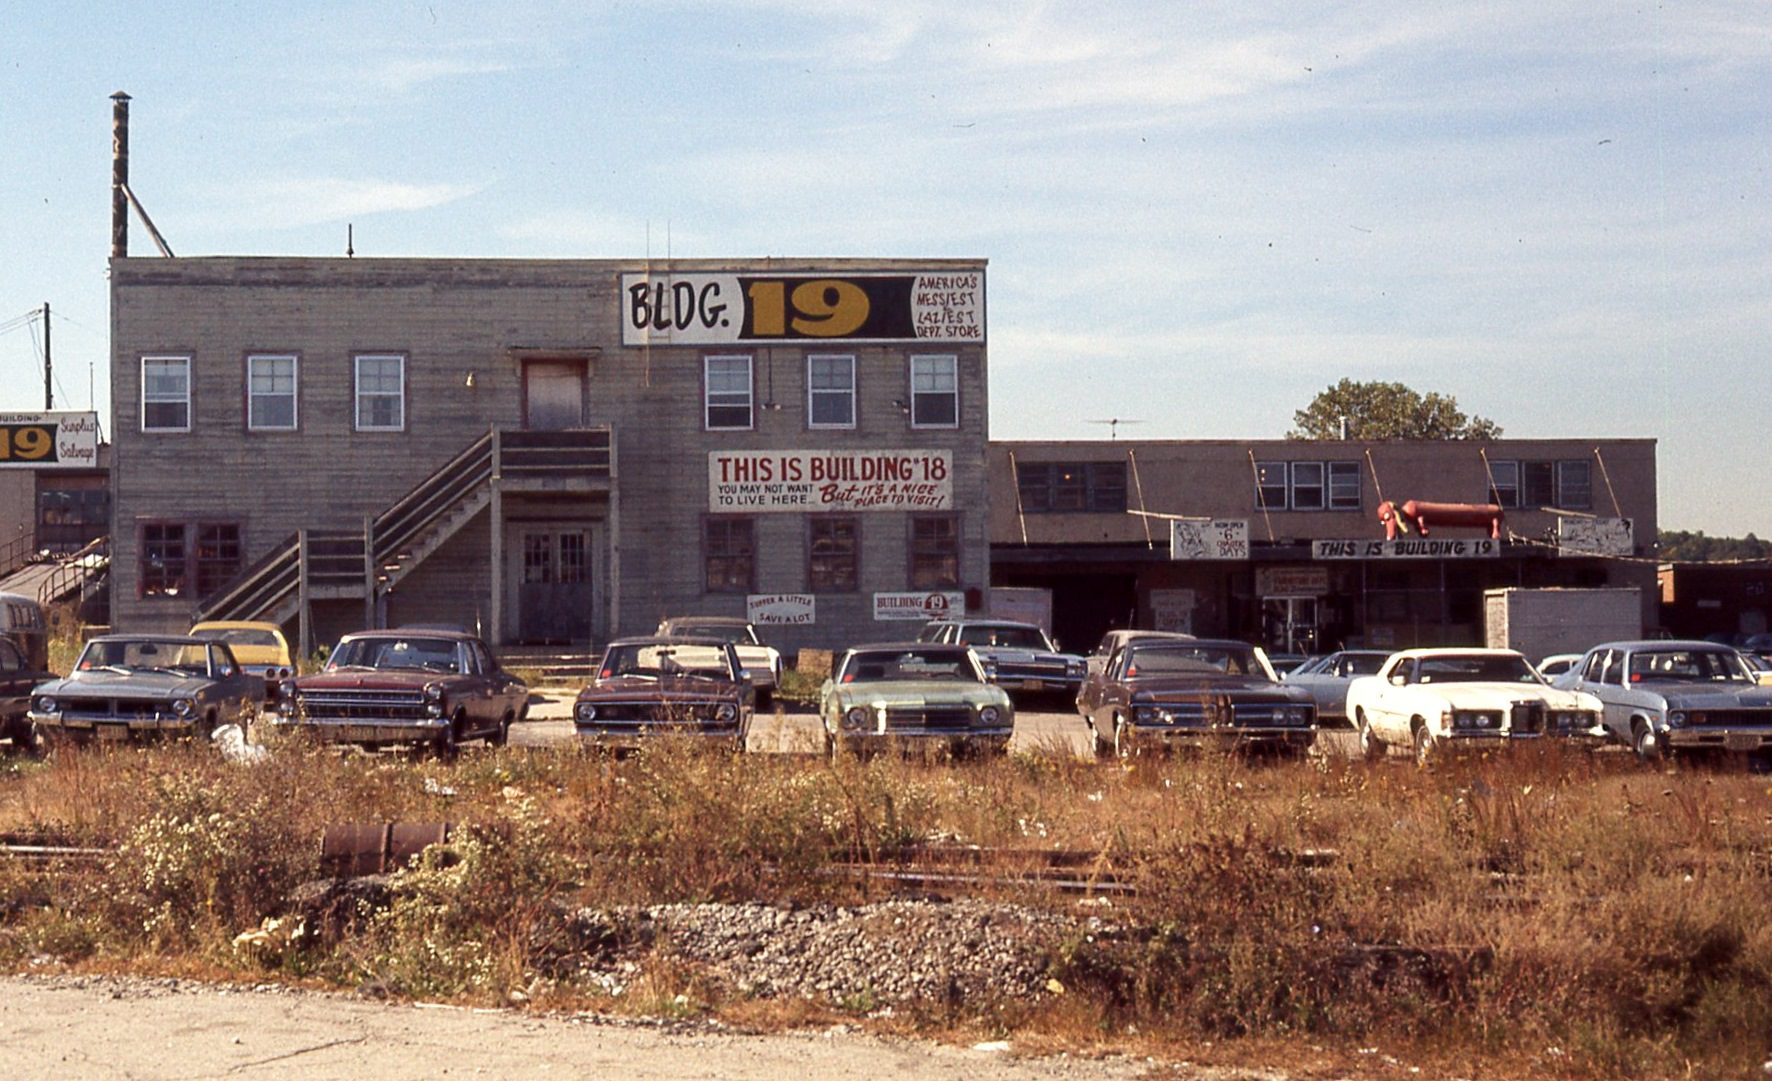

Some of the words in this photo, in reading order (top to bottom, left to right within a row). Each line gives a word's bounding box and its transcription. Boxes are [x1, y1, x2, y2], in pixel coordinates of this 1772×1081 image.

[918, 274, 978, 290] AMERICA'S
[916, 291, 975, 307] MESSIEST
[629, 281, 730, 331] BLDG.
[748, 278, 871, 337] 19
[917, 310, 975, 325] LAZIEST
[916, 325, 942, 338] DEPT.
[945, 325, 981, 338] STORE
[717, 457, 773, 482] THIS
[780, 457, 803, 482] IS
[810, 456, 913, 482] BUILDING
[718, 484, 738, 495] YOU
[740, 484, 761, 494] MAY
[764, 484, 783, 494] NOT
[787, 484, 814, 494] WANT
[819, 483, 859, 504] But
[888, 483, 897, 494] A
[901, 483, 938, 495] NICE
[718, 495, 734, 506] TO
[737, 495, 766, 505] LIVE
[854, 494, 888, 508] PLACE
[891, 494, 904, 504] TO
[906, 494, 945, 508] VISIT!
[1320, 542, 1356, 556] THIS
[1366, 542, 1383, 556] IS
[1394, 540, 1466, 556] BUILDING
[1475, 540, 1493, 554] 19
[877, 596, 923, 609] BUILDING
[928, 595, 944, 609] 19
[760, 612, 783, 623] SAVE
[793, 612, 810, 623] LOT
